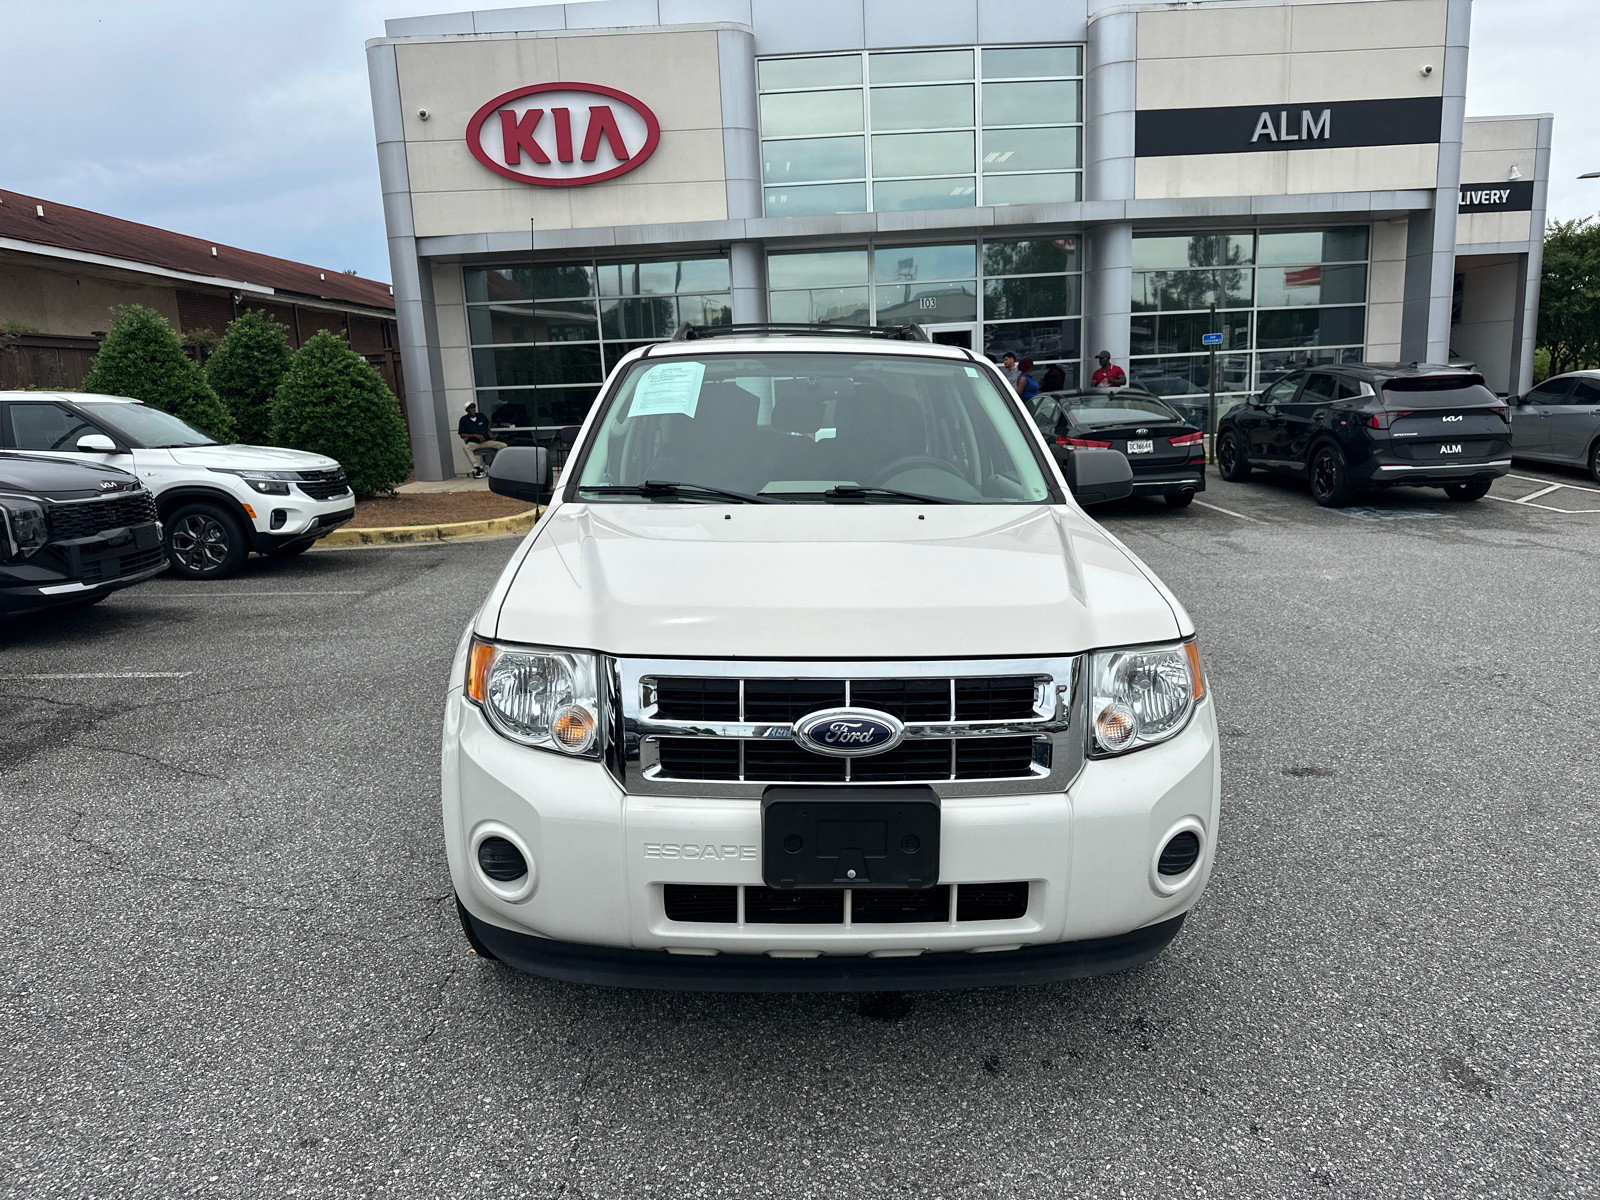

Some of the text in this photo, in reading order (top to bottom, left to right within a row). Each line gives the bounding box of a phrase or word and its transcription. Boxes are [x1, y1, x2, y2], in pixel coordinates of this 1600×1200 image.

[498, 105, 630, 165] KIA
[1249, 109, 1331, 143] ALM
[1458, 189, 1510, 205] LIVERY
[920, 297, 936, 309] 103
[1439, 444, 1462, 454] ALM
[824, 721, 874, 744] Ford
[643, 842, 757, 861] ESCAPE
